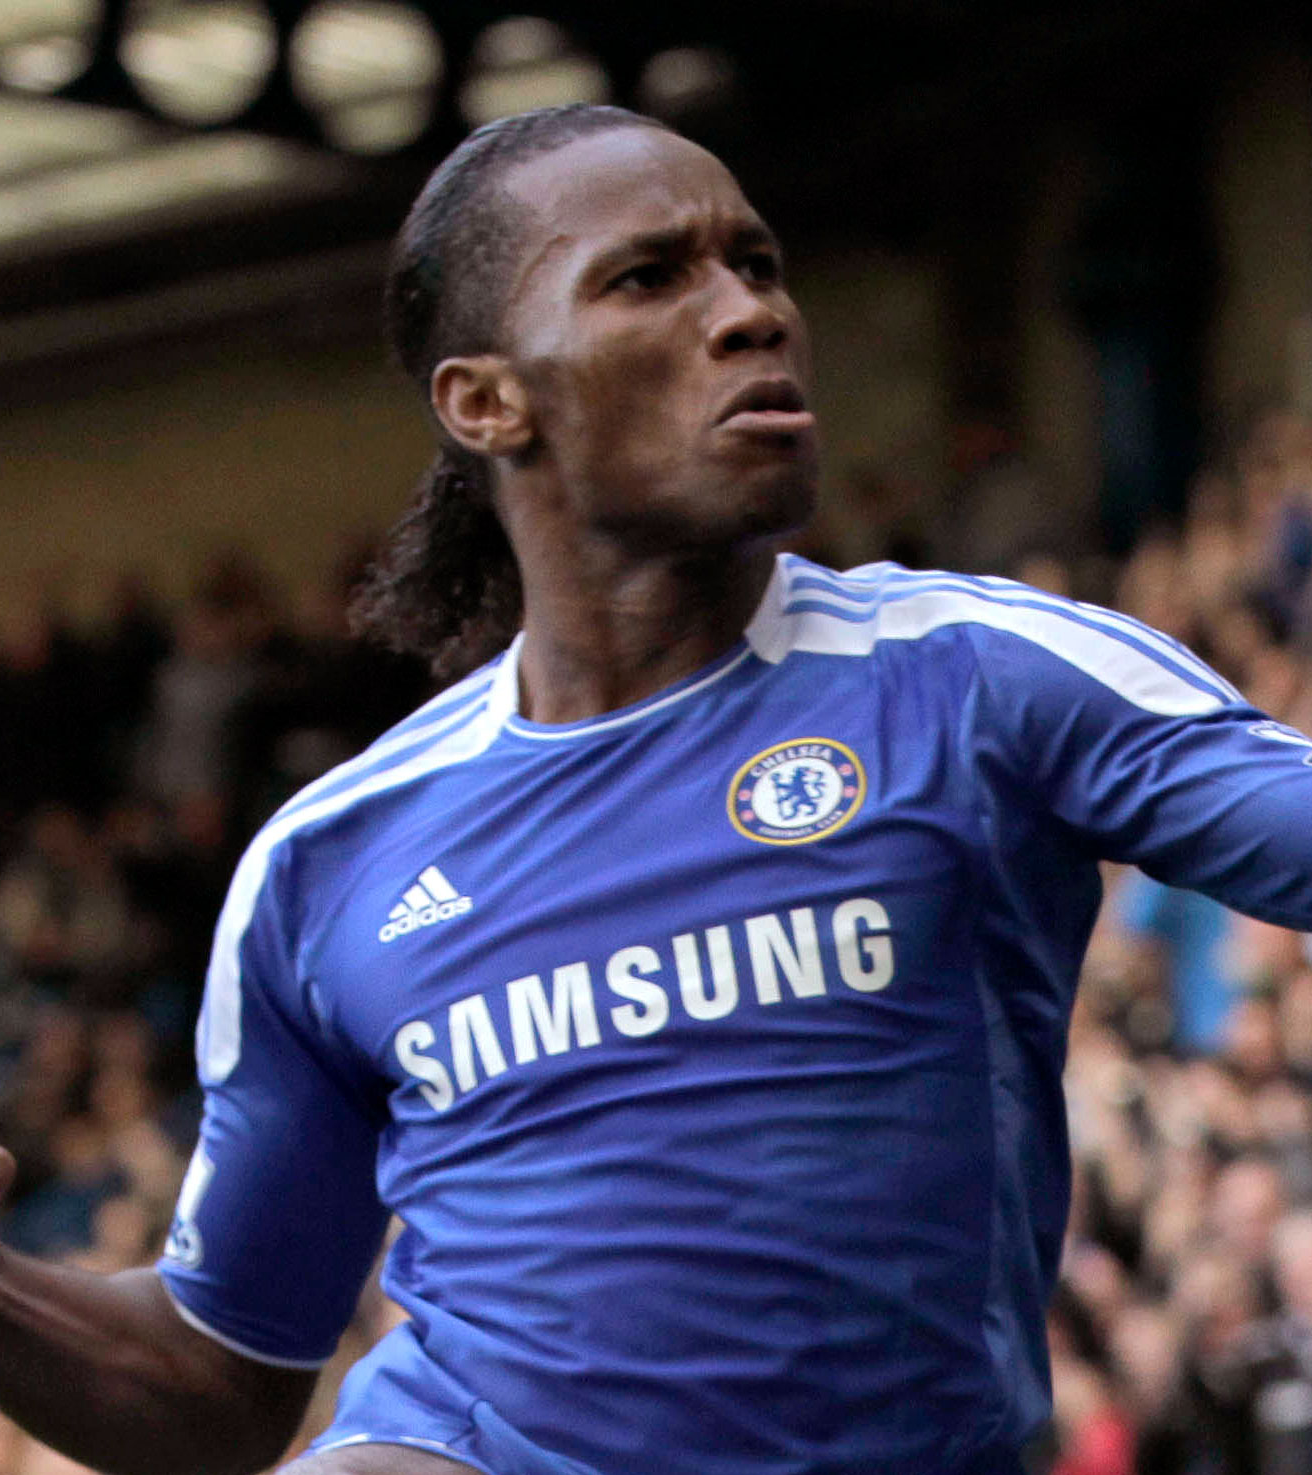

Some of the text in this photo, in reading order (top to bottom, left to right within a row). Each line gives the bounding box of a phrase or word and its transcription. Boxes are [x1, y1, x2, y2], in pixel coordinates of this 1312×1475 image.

[749, 744, 833, 777] CHELSEA
[378, 896, 473, 943] adidas
[395, 897, 894, 1113] SAMSUNG
